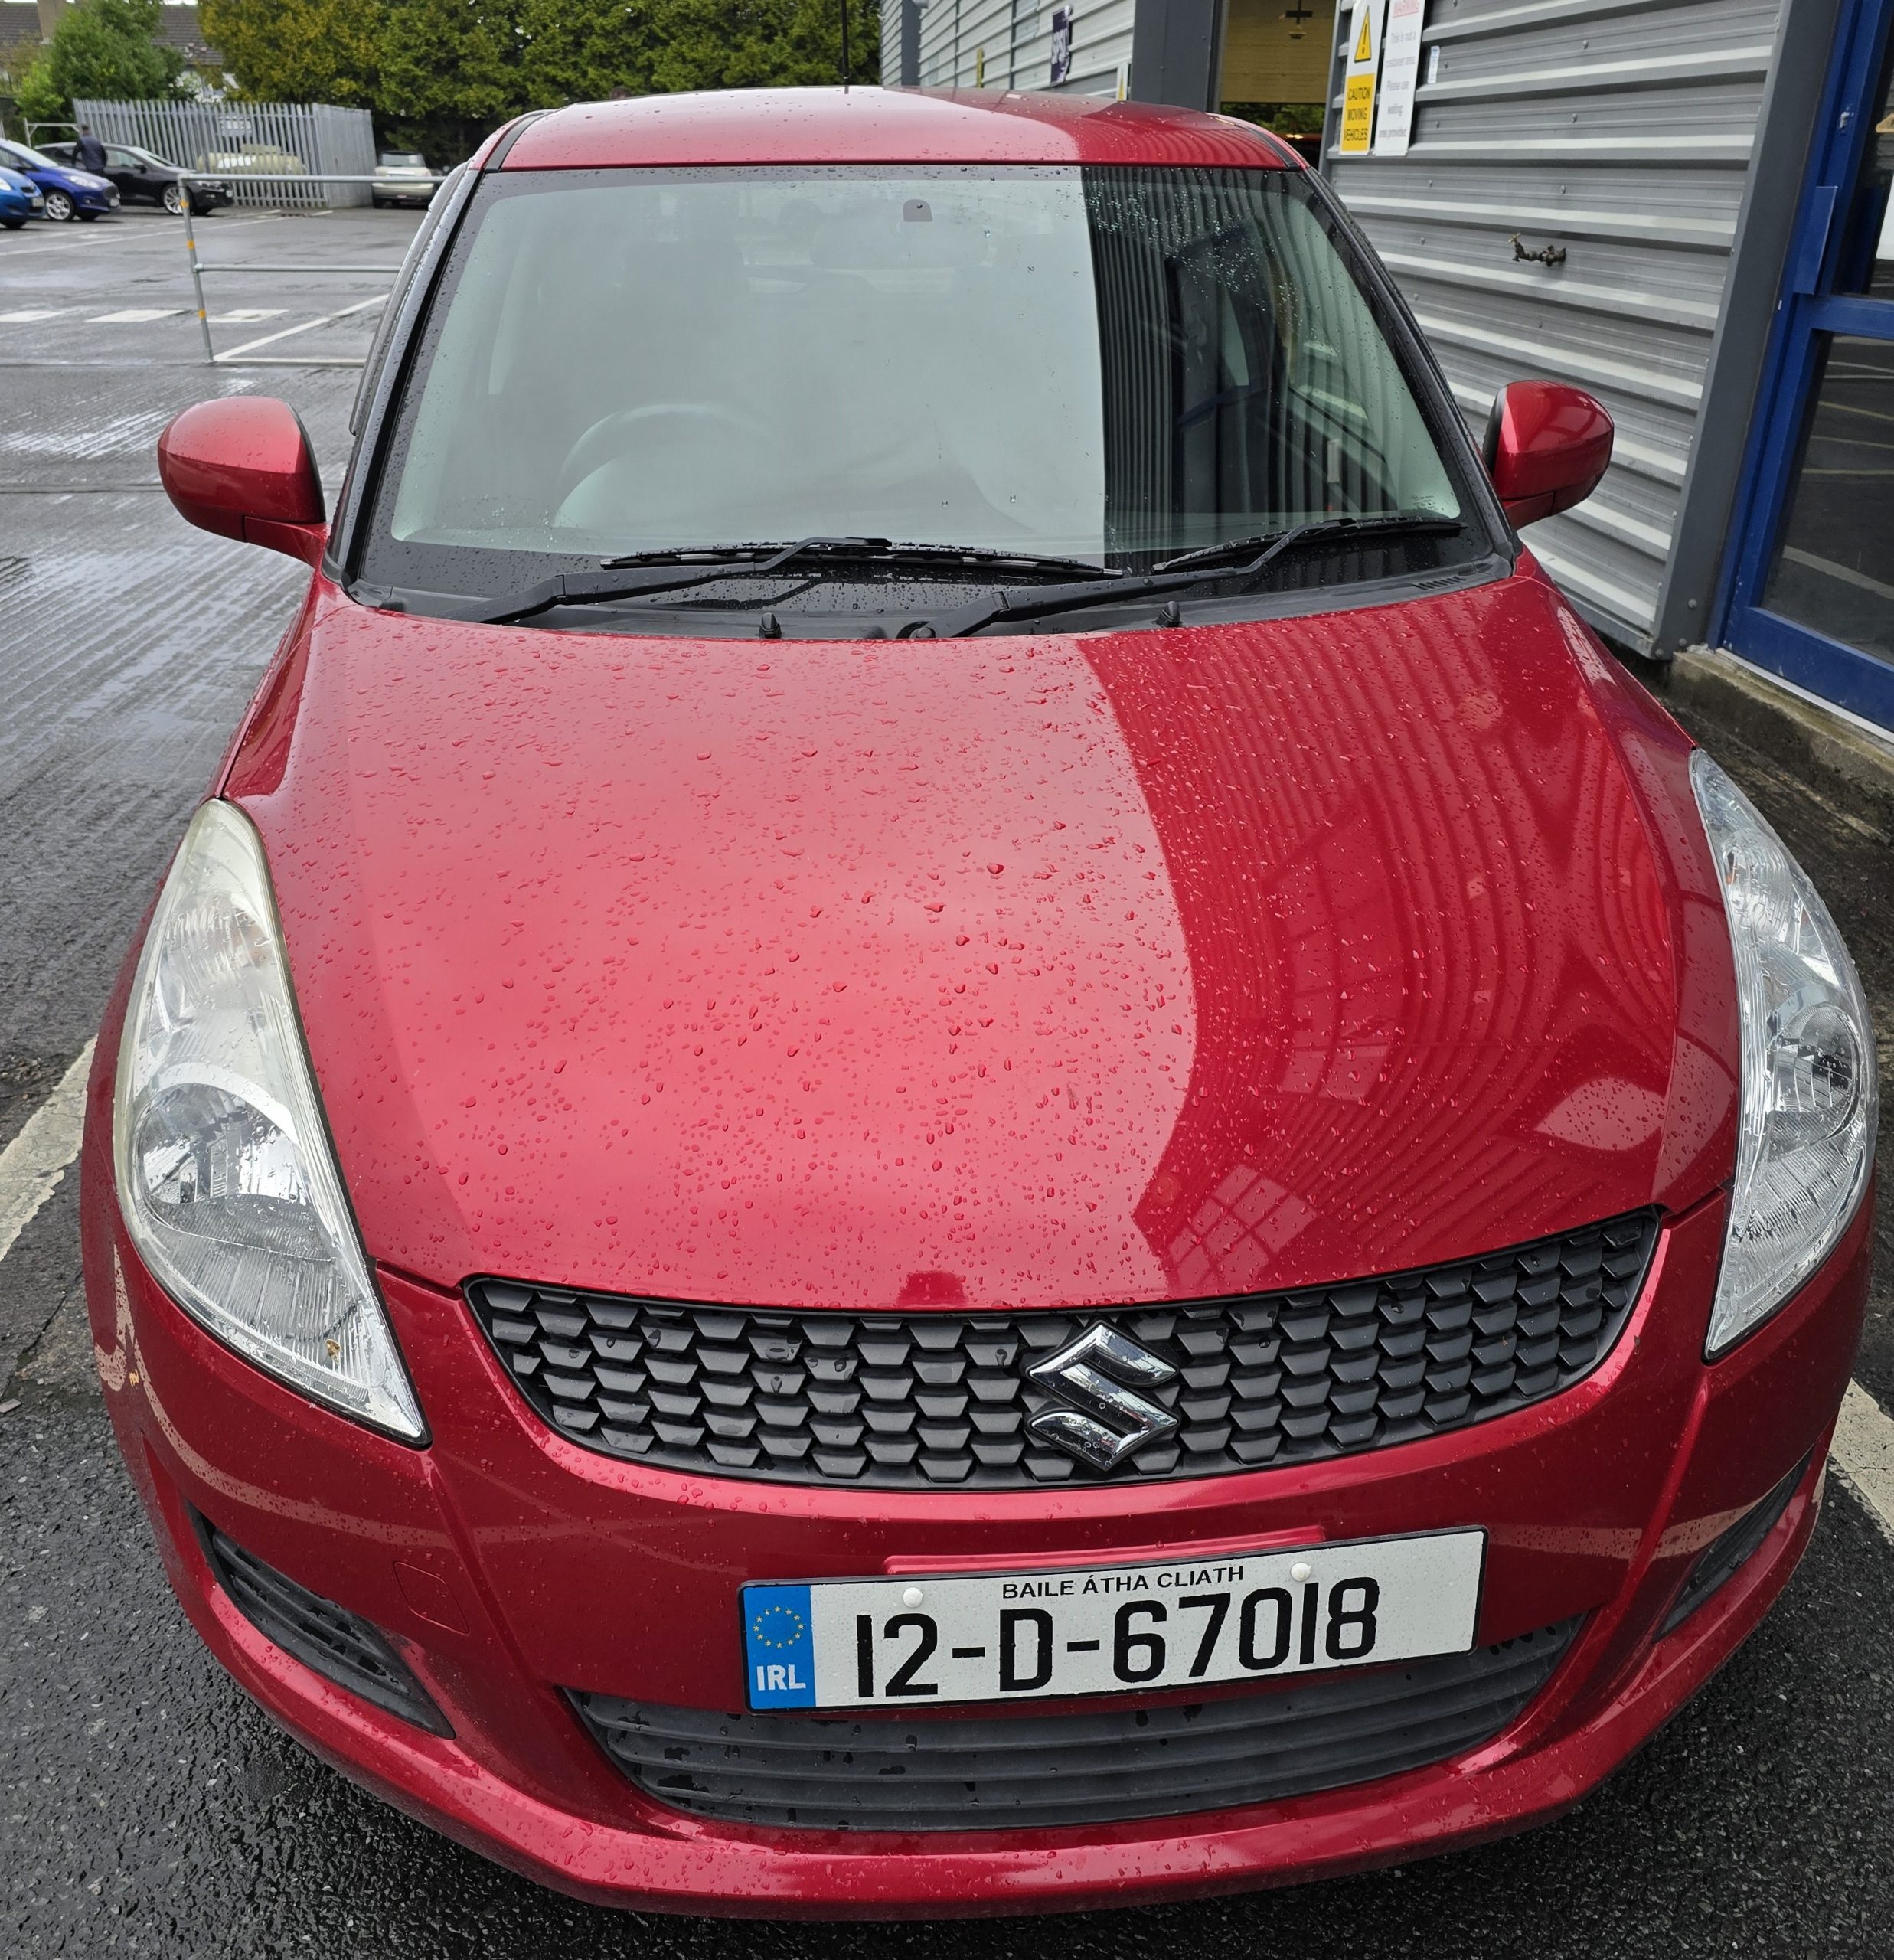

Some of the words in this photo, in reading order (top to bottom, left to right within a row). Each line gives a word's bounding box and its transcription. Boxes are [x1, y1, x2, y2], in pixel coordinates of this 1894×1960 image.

[1348, 87, 1371, 100] CAUTION
[1347, 108, 1367, 120] MOVING
[1344, 128, 1367, 141] VEHICLES
[1002, 1579, 1075, 1599] BAILE
[1083, 1573, 1149, 1595] ÁTHA
[1157, 1566, 1244, 1588] CLIATH
[857, 1576, 1380, 1697] 12-D-67018
[756, 1664, 806, 1690] IRL
